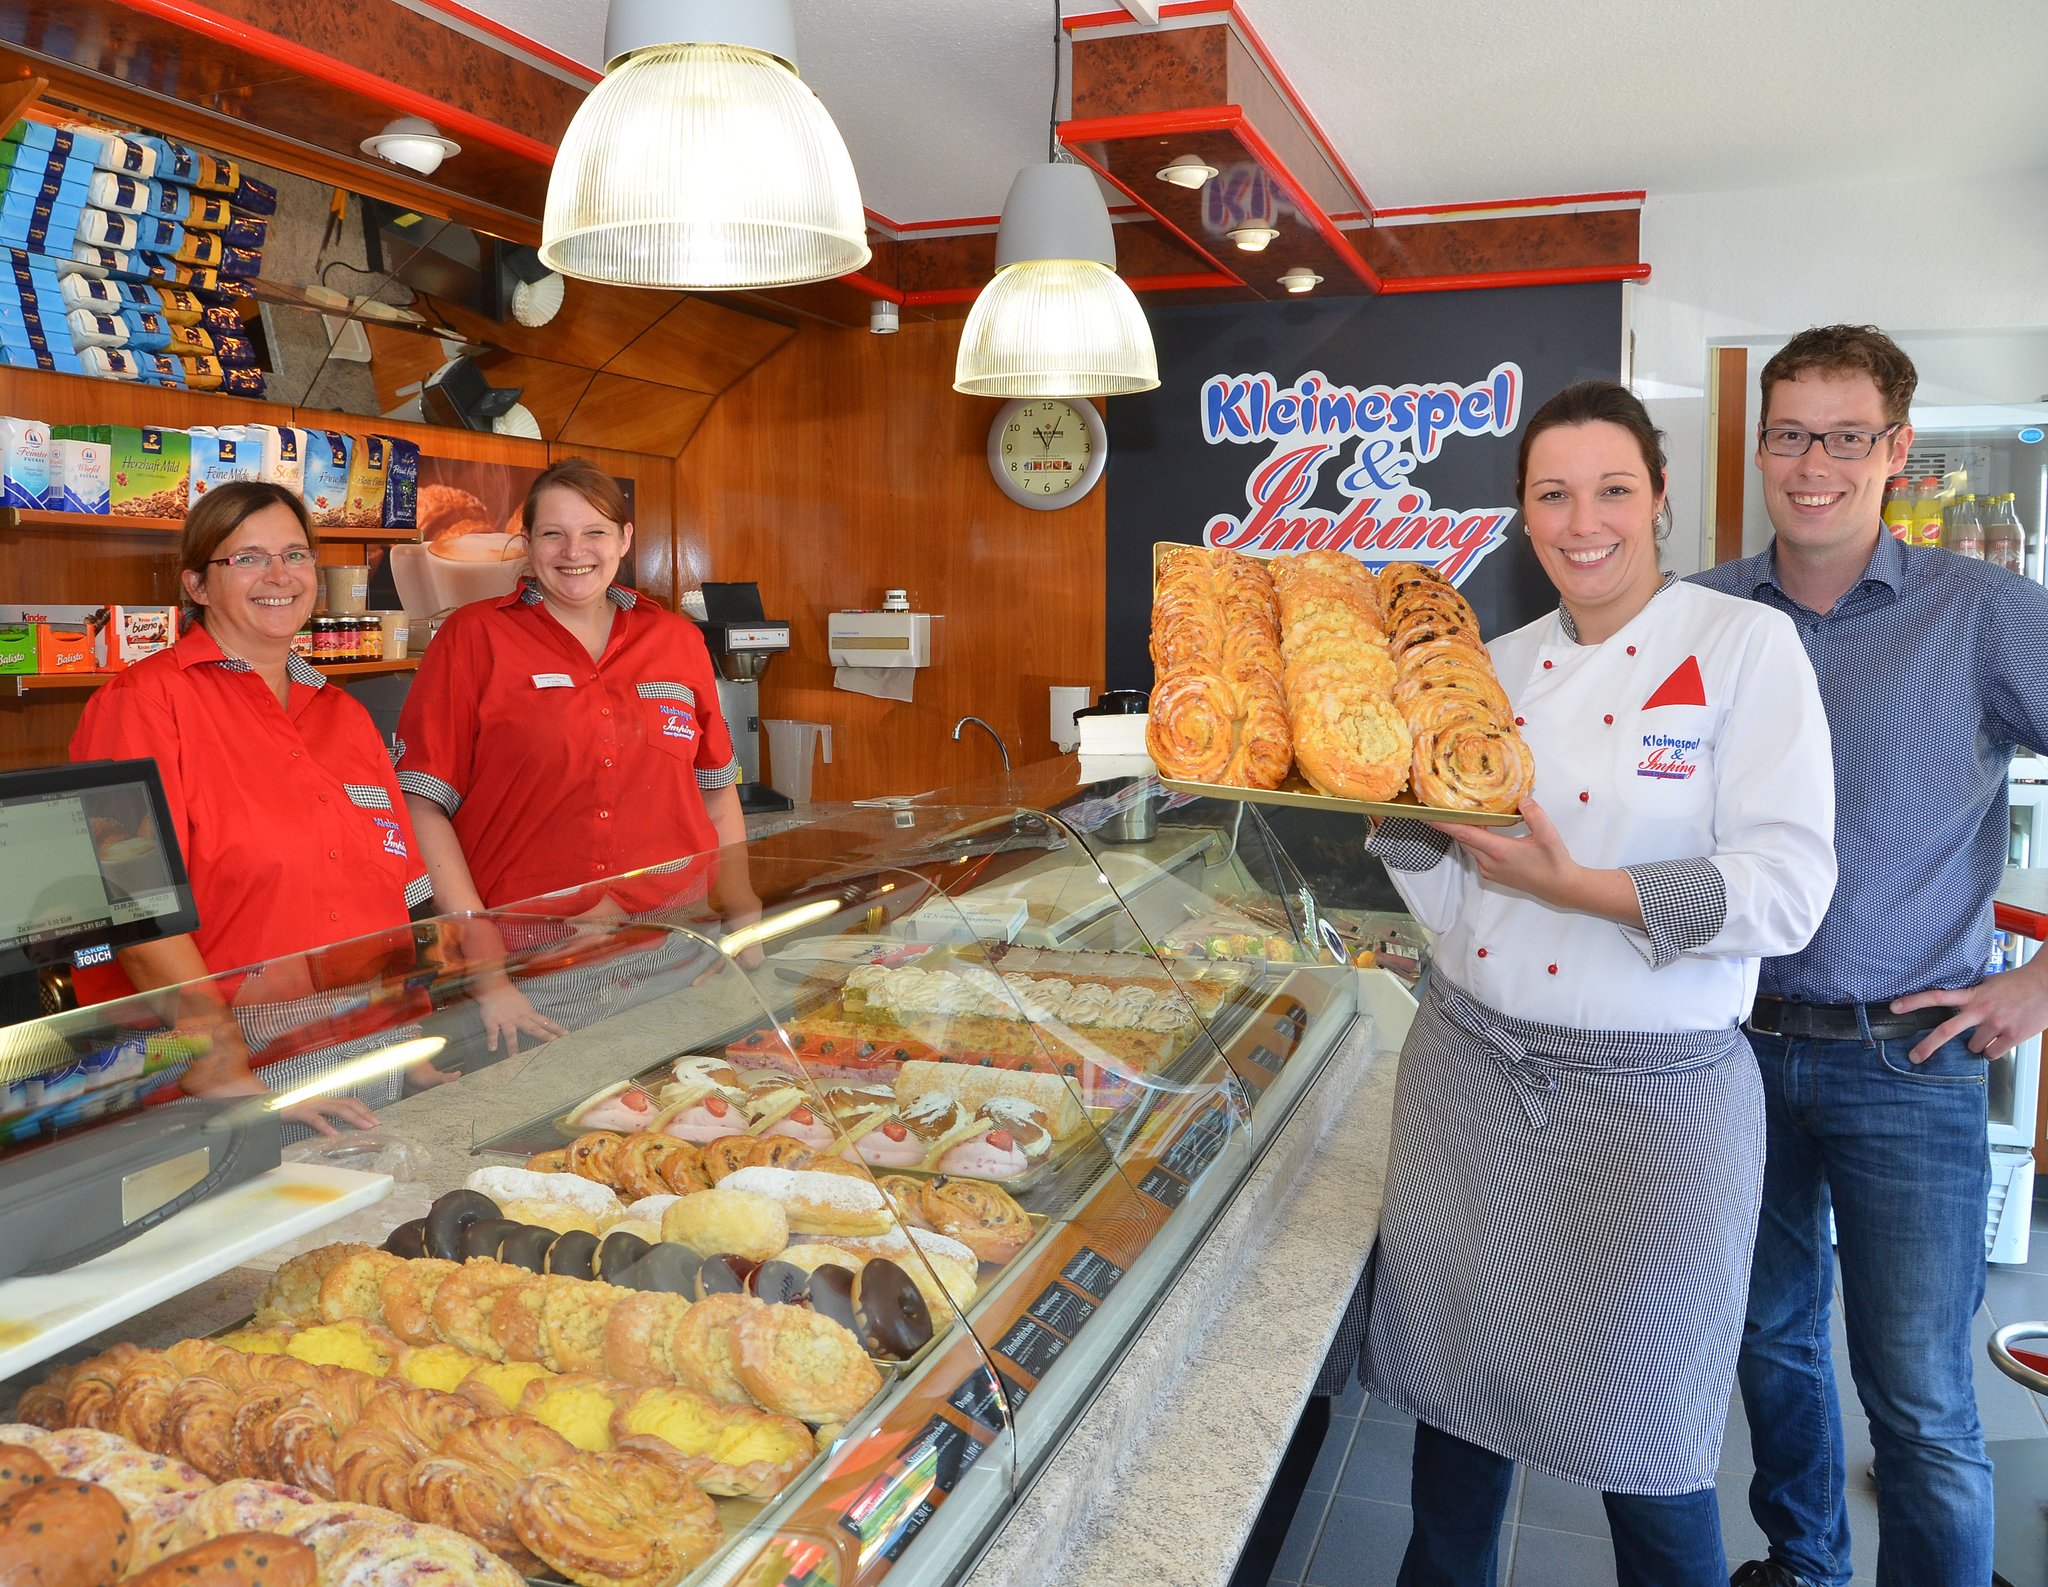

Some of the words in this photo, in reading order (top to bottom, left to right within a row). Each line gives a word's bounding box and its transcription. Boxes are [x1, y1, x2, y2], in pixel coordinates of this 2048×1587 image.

[1023, 409, 1033, 417] 11
[1066, 408, 1072, 416] 1
[1205, 367, 1516, 458] Kleinespel
[1009, 424, 1021, 432] 10
[1079, 423, 1086, 431] 2
[1006, 444, 1013, 454] 9
[1084, 443, 1090, 453] 3
[122, 456, 160, 471] Herzhaft
[160, 461, 180, 473] Mild
[1011, 462, 1018, 472] 8
[1078, 463, 1085, 473] 4
[1343, 439, 1411, 491] &
[206, 466, 228, 480] Feine
[1024, 479, 1030, 489] 7
[1044, 483, 1051, 493] 6
[1064, 479, 1070, 489] 5
[1209, 443, 1507, 584] Imping
[132, 622, 158, 634] bueno
[55, 652, 84, 666] Balisto
[1642, 734, 1701, 751] Kleinespel
[1671, 749, 1684, 760] &
[1638, 747, 1697, 779] Imping
[28, 934, 42, 944] EUR
[94, 920, 107, 928] EUR
[78, 950, 112, 967] TOUCH
[1002, 1320, 1035, 1355] Zitrobrötchen
[955, 1388, 975, 1410] Donut
